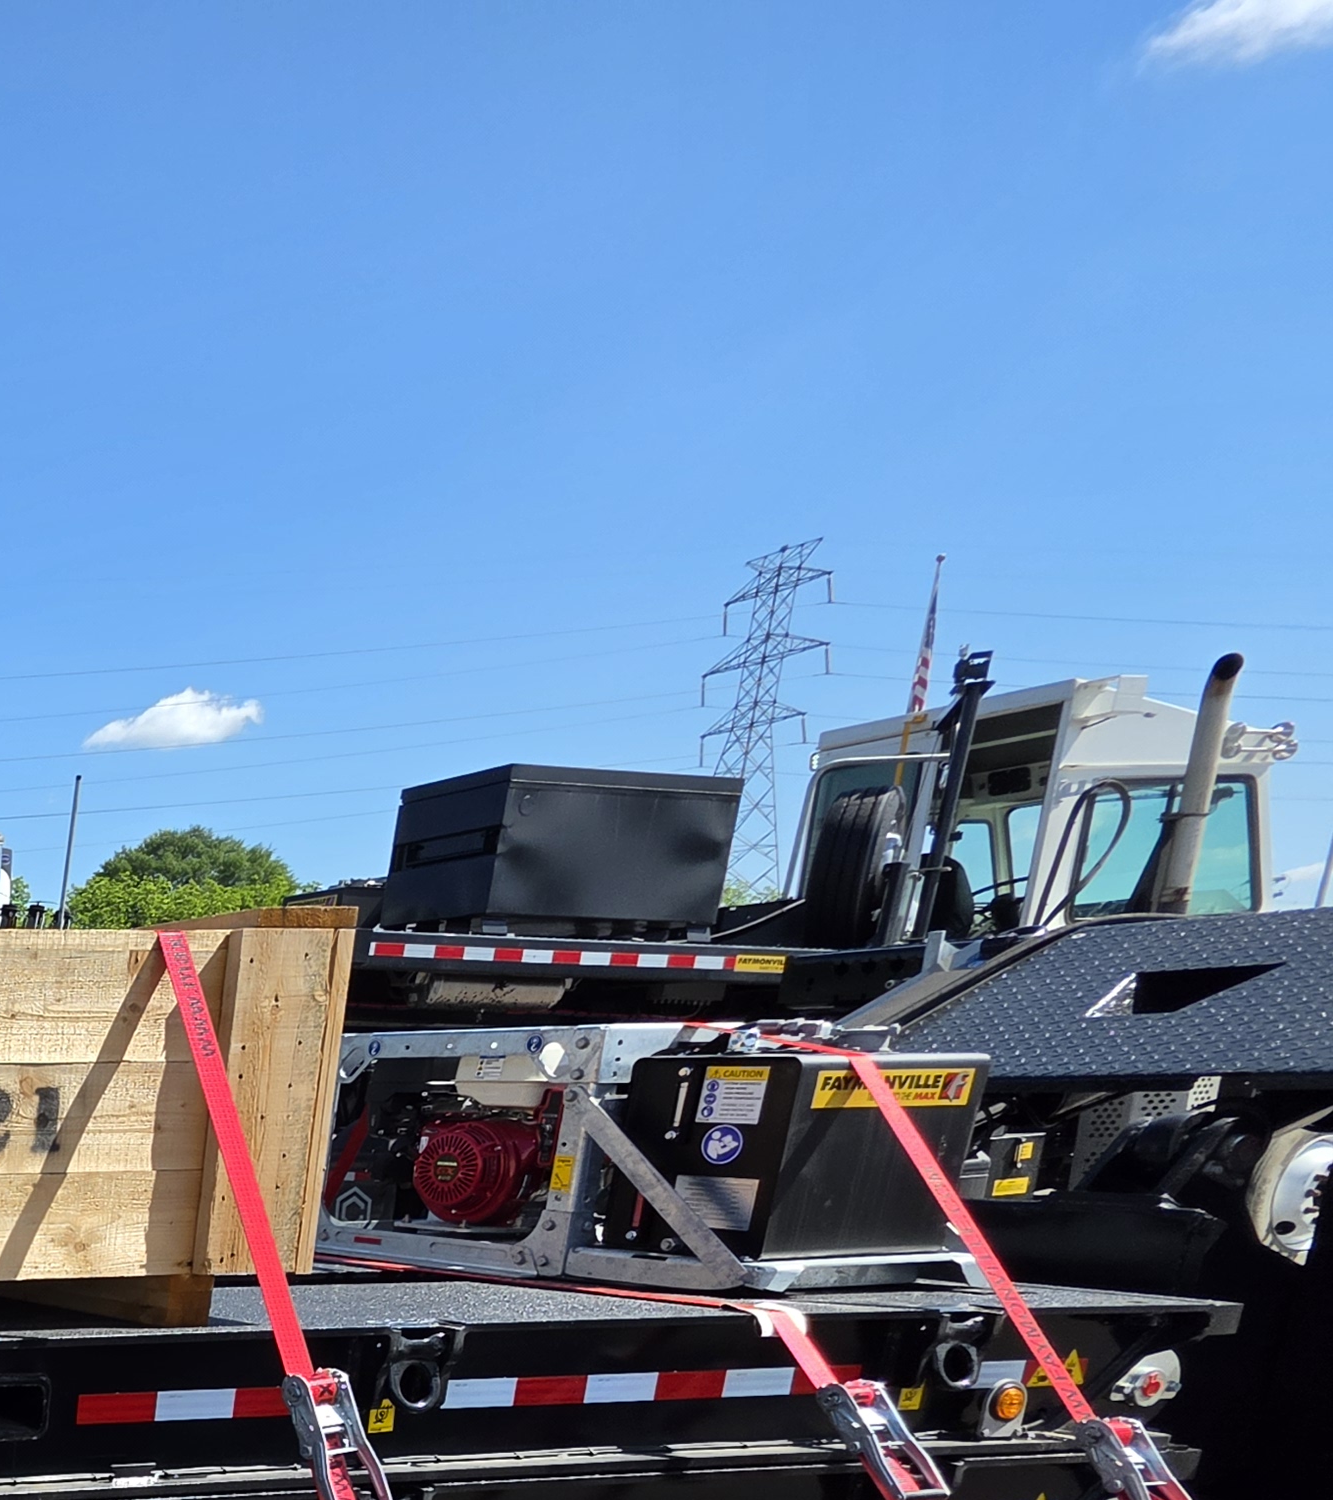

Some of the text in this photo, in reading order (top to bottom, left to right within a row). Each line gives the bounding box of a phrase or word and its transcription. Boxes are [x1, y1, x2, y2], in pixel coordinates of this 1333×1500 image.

[723, 1069, 764, 1079] CAUTION
[820, 1074, 943, 1091] FAYMNVILLE
[913, 1091, 937, 1100] MAX
